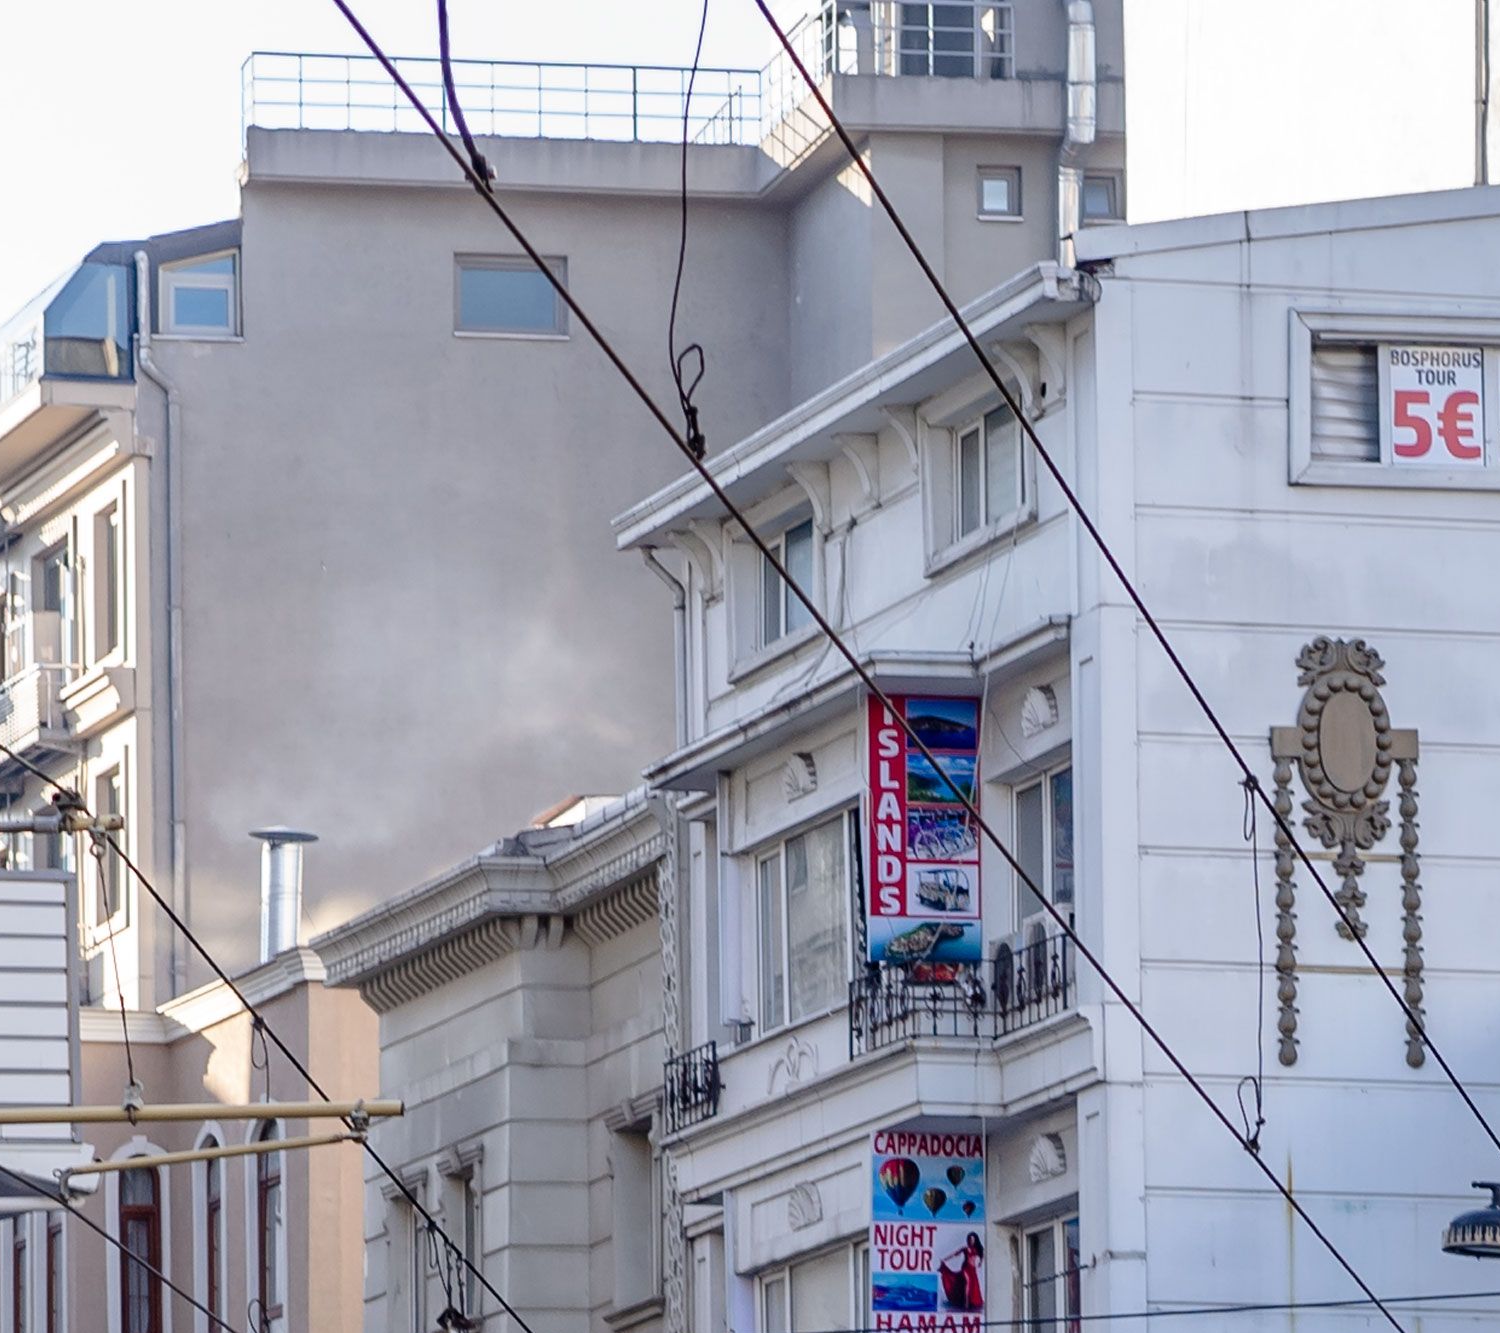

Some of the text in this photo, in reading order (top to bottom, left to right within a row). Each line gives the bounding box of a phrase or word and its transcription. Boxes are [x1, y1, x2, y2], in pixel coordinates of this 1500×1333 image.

[1391, 350, 1480, 369] BOSPHORUS
[1416, 369, 1457, 386] TOUR
[1394, 390, 1481, 459] 5€
[877, 698, 902, 916] ISLANDS
[874, 1132, 983, 1158] CAPPADOCIA
[874, 1225, 937, 1248] NIGHT
[878, 1249, 933, 1272] TOUR
